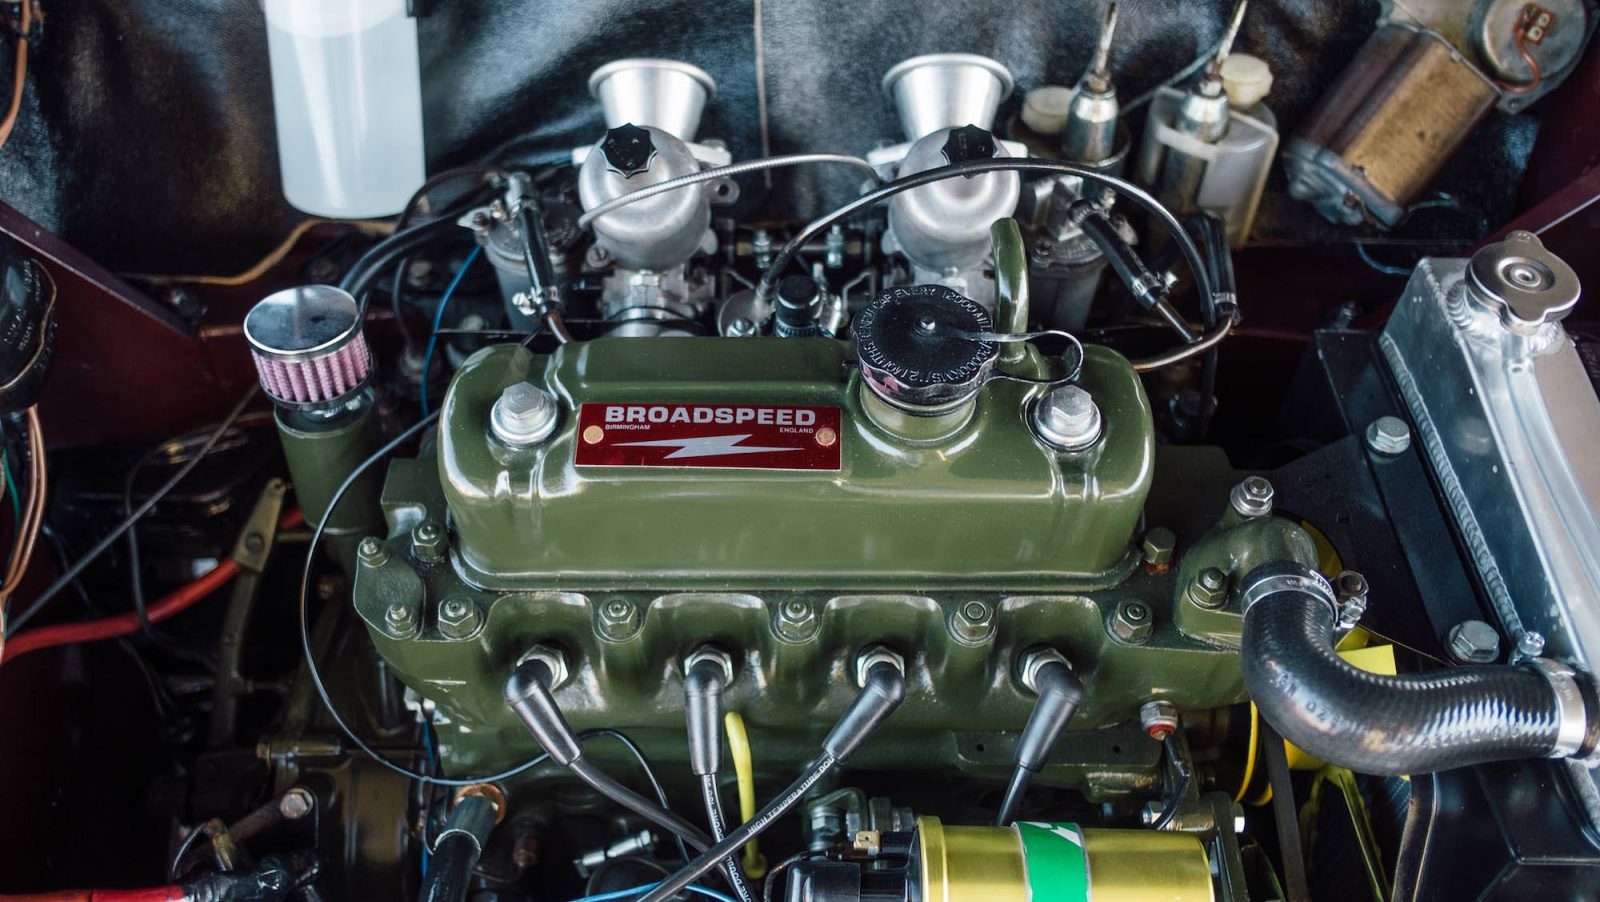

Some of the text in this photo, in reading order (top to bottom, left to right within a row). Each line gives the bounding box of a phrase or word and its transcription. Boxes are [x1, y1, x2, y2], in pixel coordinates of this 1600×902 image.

[895, 286, 937, 299] EVERY
[604, 405, 817, 427] BROADSPEED
[747, 756, 836, 835] HIGH TEMPERATURE DOU
[725, 855, 742, 885] DOUBL
